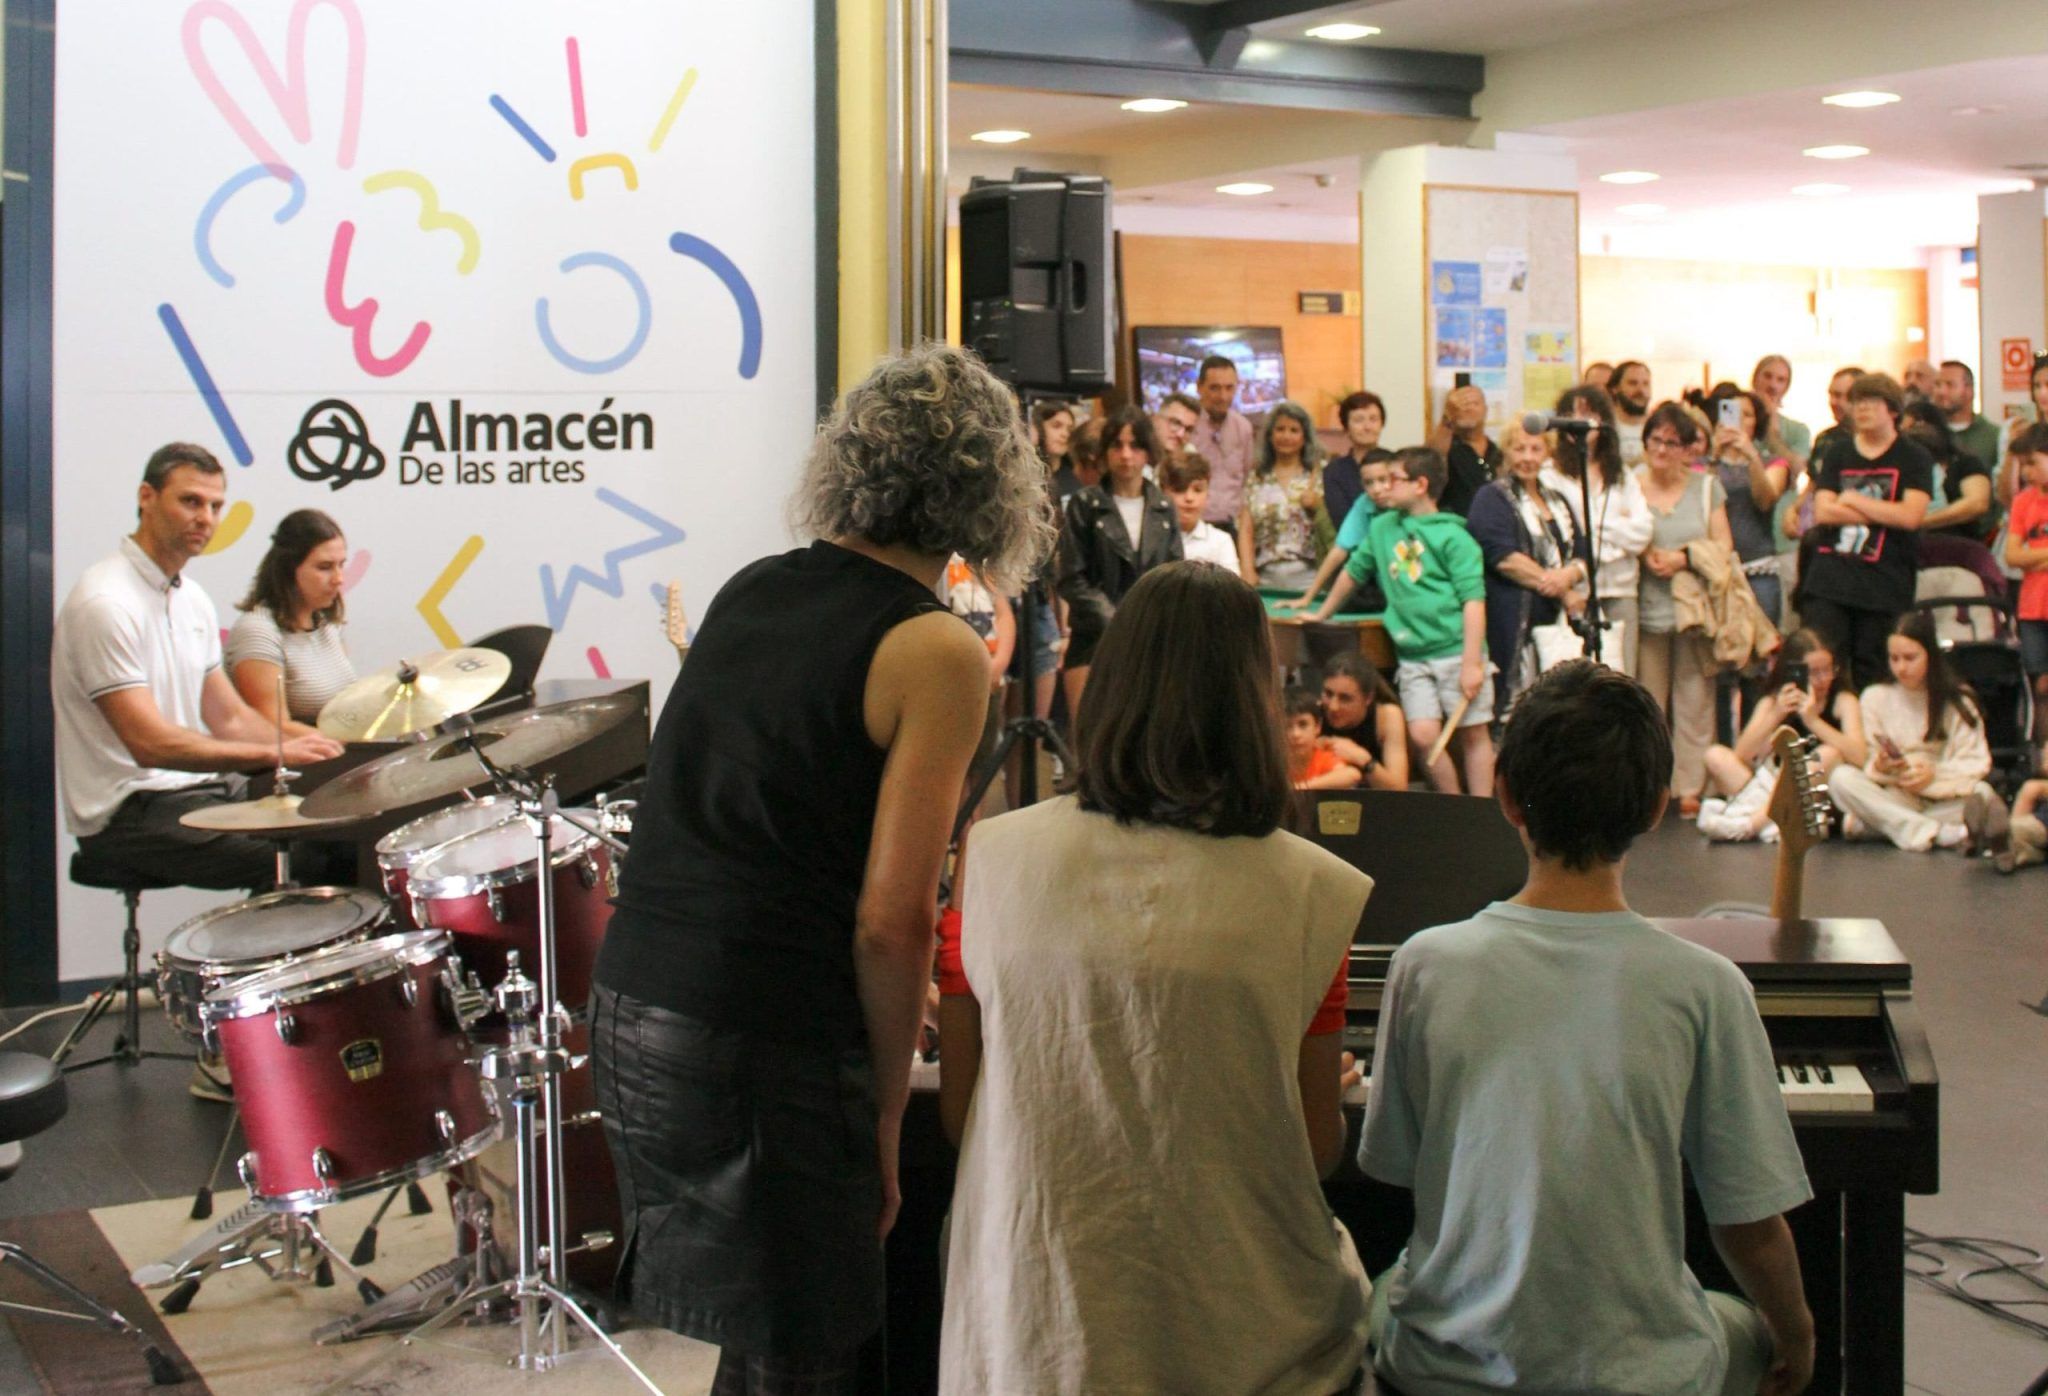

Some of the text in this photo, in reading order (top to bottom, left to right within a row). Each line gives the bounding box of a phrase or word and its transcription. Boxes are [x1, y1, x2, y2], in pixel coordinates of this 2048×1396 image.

[401, 397, 654, 453] Almacén
[399, 453, 585, 485] De las artes
